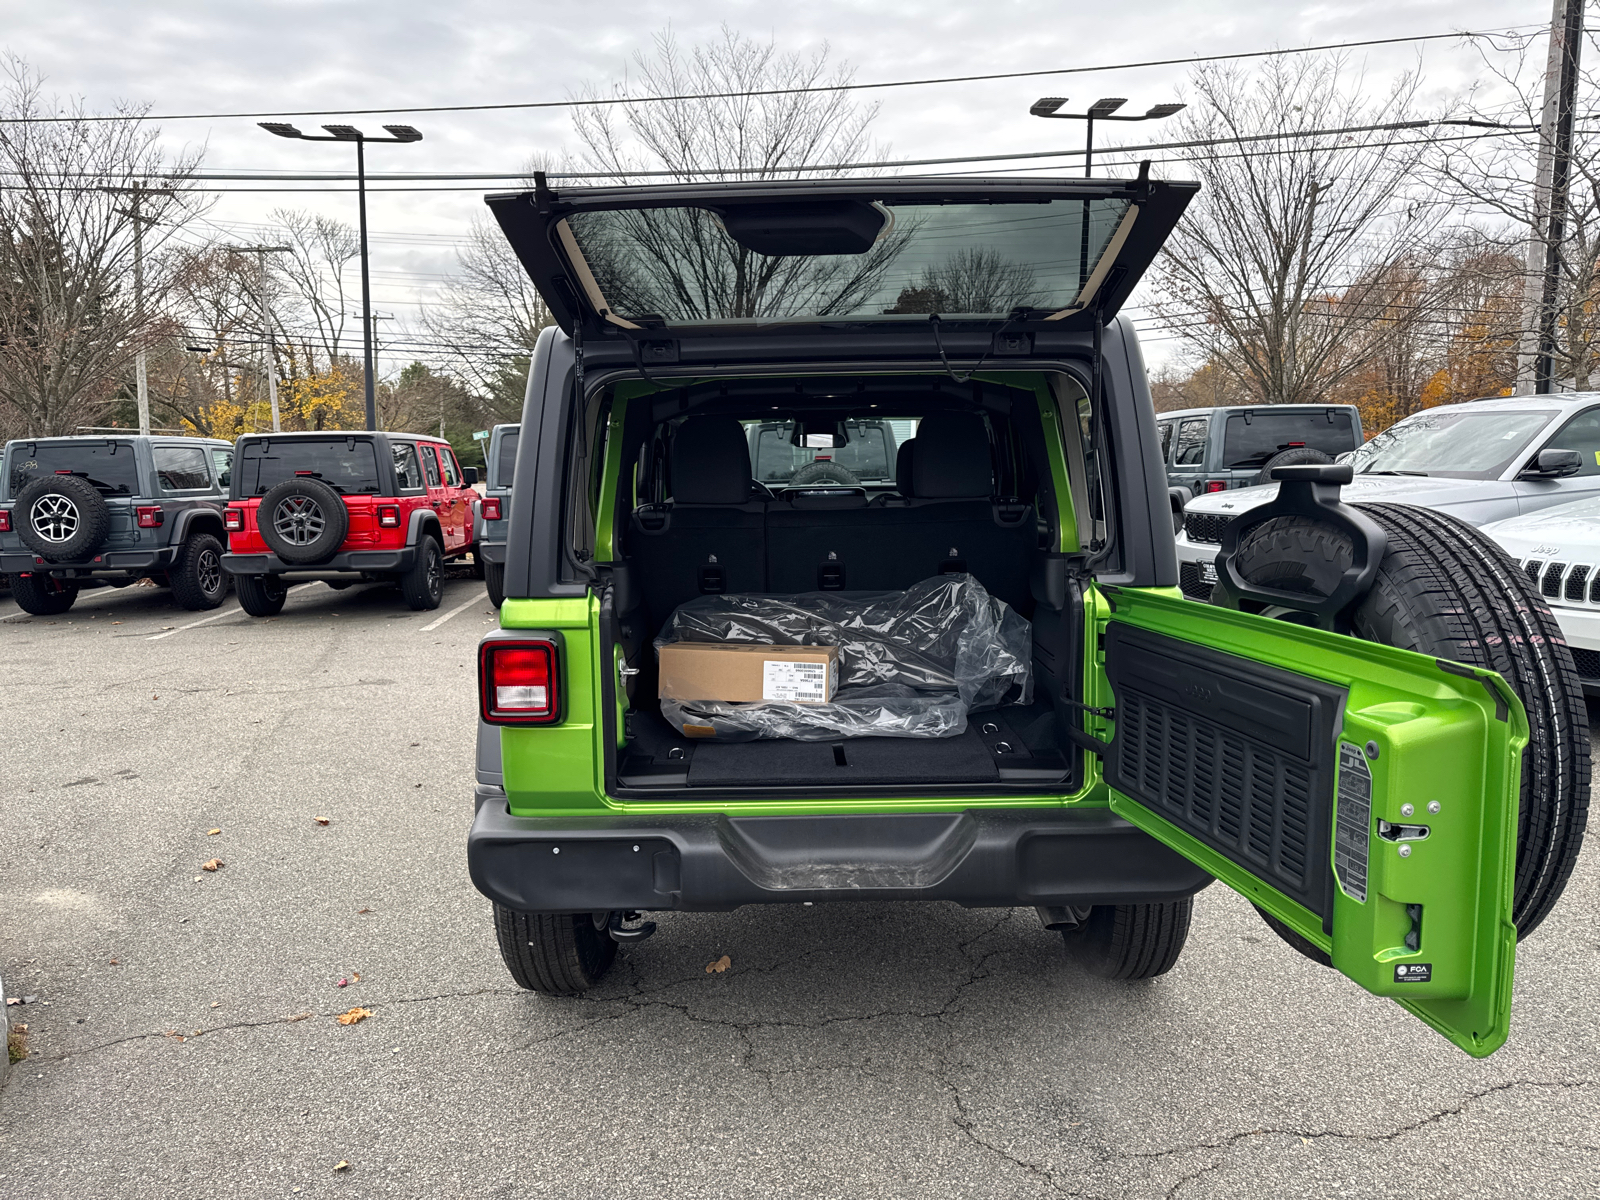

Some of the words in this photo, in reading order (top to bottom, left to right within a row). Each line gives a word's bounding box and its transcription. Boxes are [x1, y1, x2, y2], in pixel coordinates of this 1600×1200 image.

[1530, 543, 1561, 557] Jeep
[1341, 756, 1367, 771] JL
[1410, 965, 1427, 973] FCA
